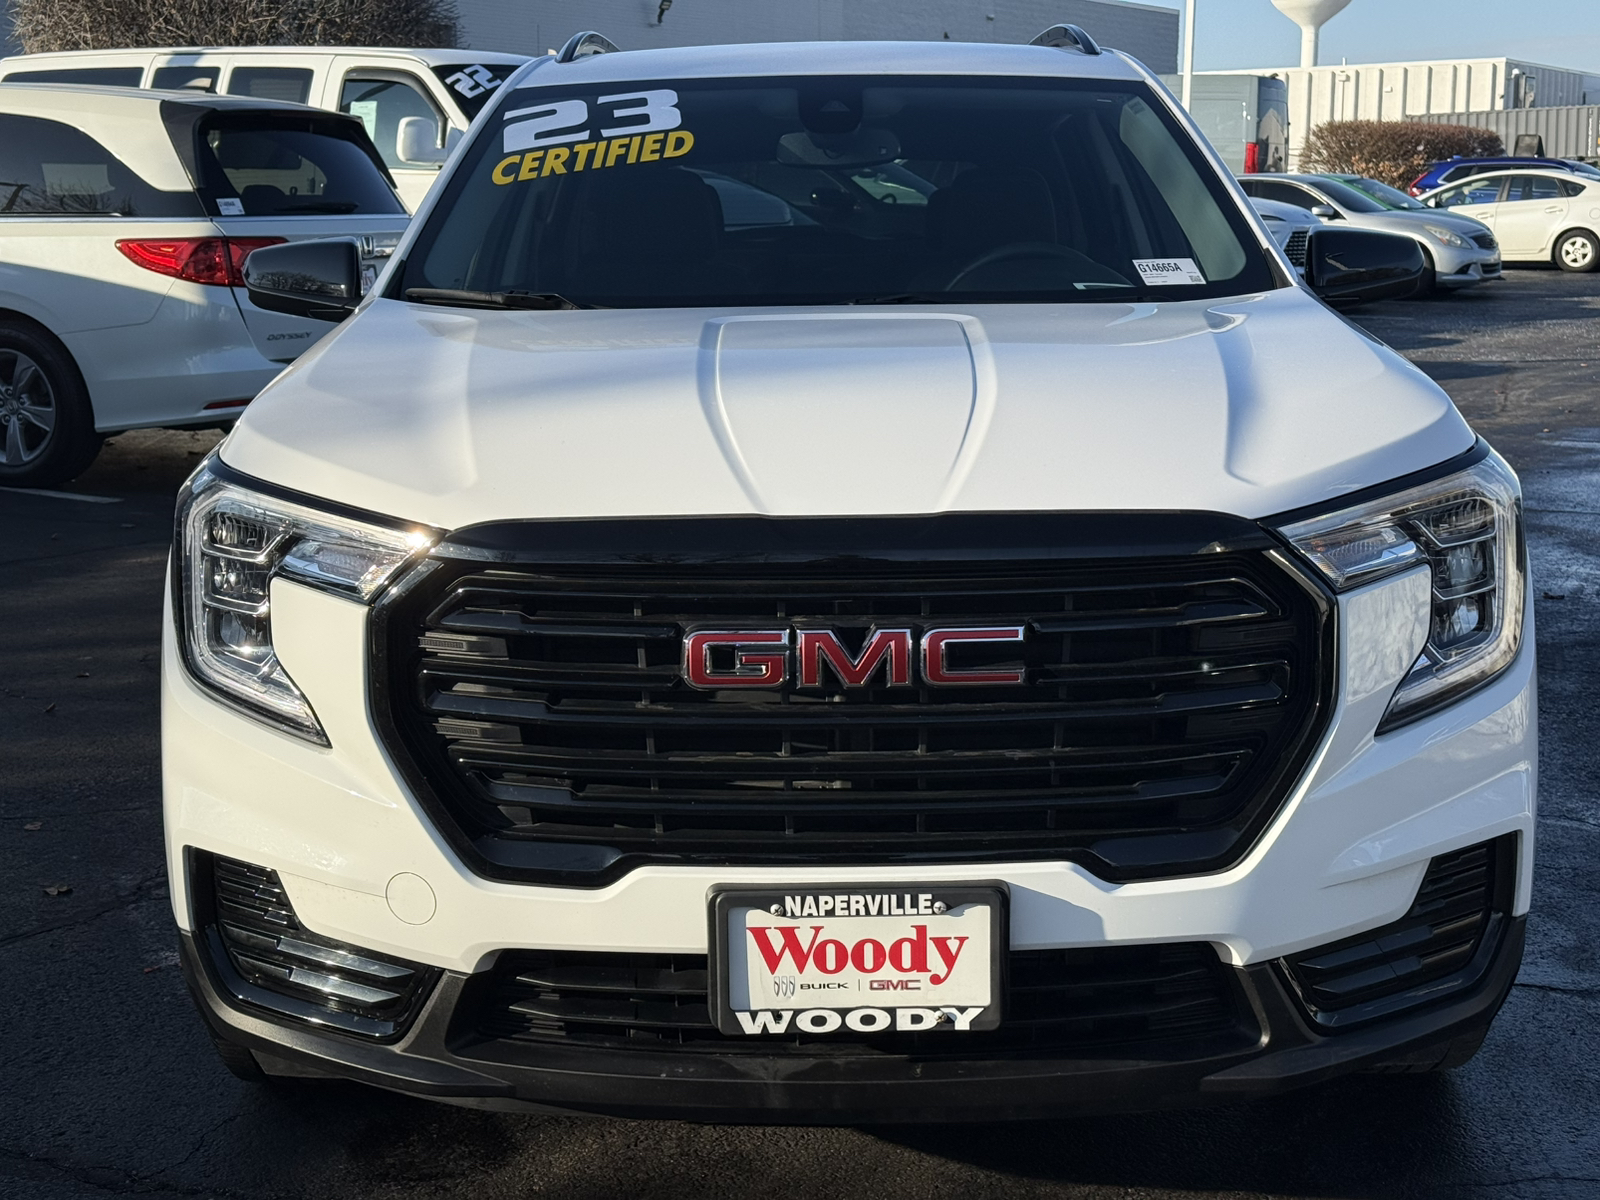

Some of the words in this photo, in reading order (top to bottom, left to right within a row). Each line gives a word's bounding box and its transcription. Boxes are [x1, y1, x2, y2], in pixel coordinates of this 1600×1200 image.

[444, 64, 502, 99] 22
[503, 89, 682, 153] 23
[491, 130, 695, 185] CERTIFIED
[1137, 262, 1183, 273] G14665A
[267, 331, 312, 341] ODYSSEY
[682, 626, 1026, 690] GMC
[784, 893, 934, 918] NAPERVILLE
[746, 925, 969, 985] Woody
[800, 982, 849, 990] BUICK
[869, 979, 922, 991] GMC
[735, 1006, 985, 1035] WOODY
